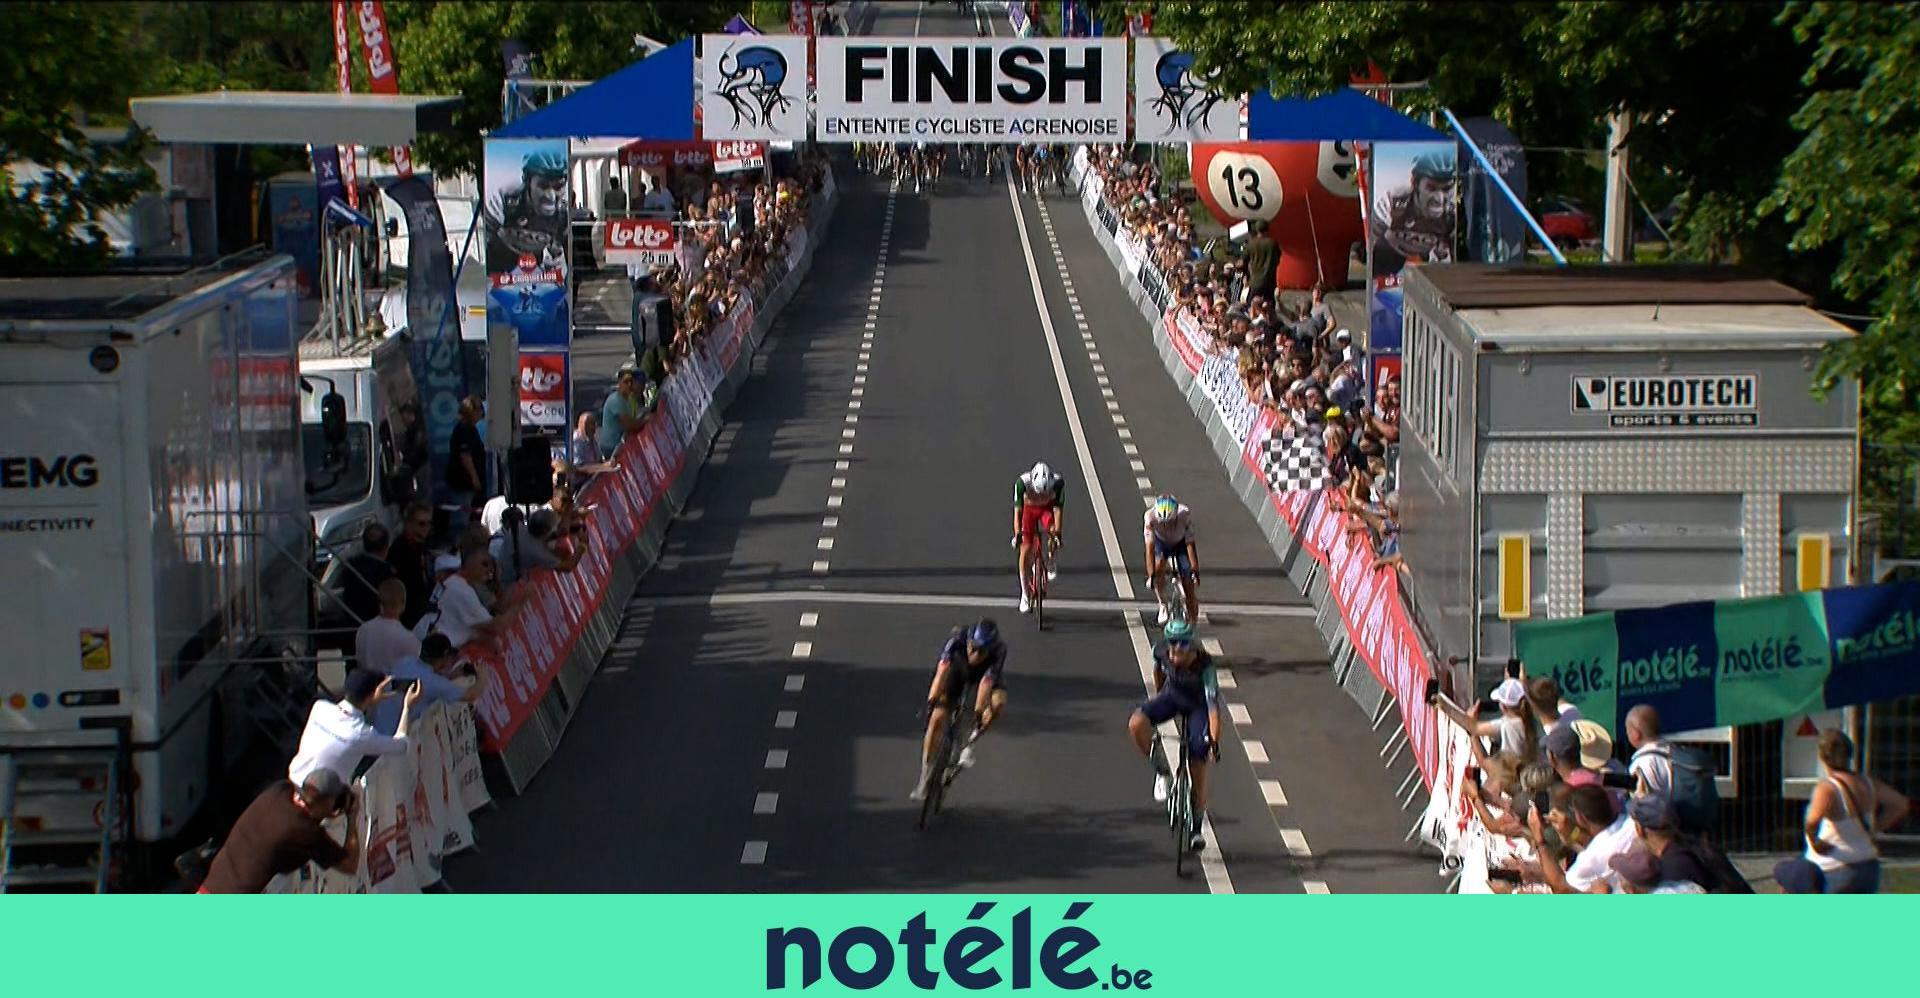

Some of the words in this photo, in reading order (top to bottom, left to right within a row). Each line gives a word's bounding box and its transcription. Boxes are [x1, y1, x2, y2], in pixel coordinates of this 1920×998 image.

[845, 45, 1102, 104] FINISH
[826, 118, 911, 134] ENTENTE
[915, 118, 1005, 135] CYCLISTE
[1009, 118, 1118, 135] ACRENOISE
[674, 149, 710, 165] lotto
[1222, 163, 1263, 211] 13
[611, 221, 669, 247] lotto
[640, 251, 655, 263] 25
[657, 253, 669, 263] m
[521, 366, 562, 392] tto
[1613, 378, 1752, 407] EUROTECH
[1614, 415, 1673, 426] sports
[1679, 414, 1690, 424] &
[1697, 414, 1752, 424] events
[0, 454, 99, 488] EMG
[1836, 610, 1920, 662] notél
